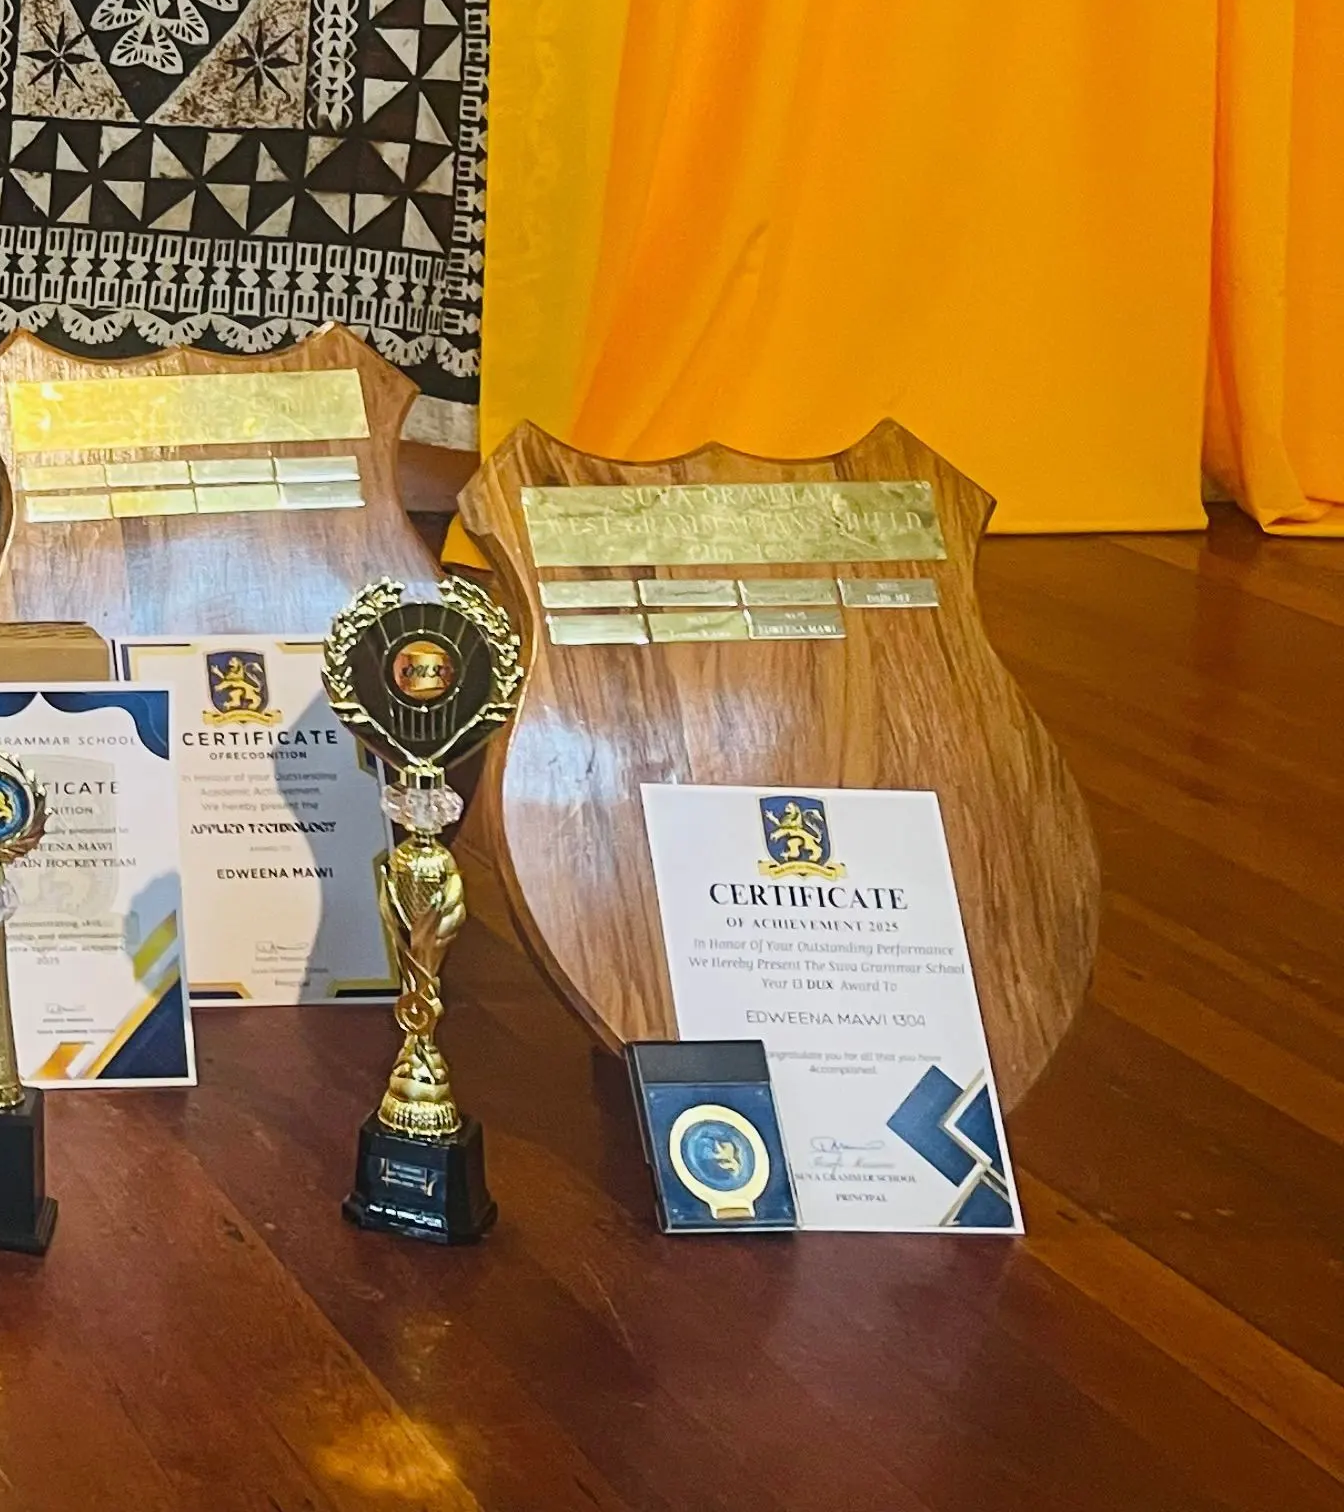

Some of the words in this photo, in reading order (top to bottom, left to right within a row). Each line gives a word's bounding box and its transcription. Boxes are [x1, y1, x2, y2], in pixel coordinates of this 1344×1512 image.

[78, 737, 137, 745] SCHOOL
[183, 730, 339, 746] CERTIFICATE
[46, 859, 99, 868] HOCKEY
[217, 868, 288, 879] EDWEENA
[293, 868, 333, 878] MAWI
[709, 883, 908, 910] CERTIFICATE
[726, 917, 744, 928] OF
[752, 918, 863, 932] ACHIEVEMENT
[766, 941, 793, 952] Your
[797, 941, 874, 956] Outstanding
[877, 943, 955, 957] Performance
[758, 959, 800, 972] Present
[804, 960, 826, 972] The
[807, 979, 833, 990] DUX
[746, 1010, 833, 1025] EDWEENA
[837, 1014, 887, 1026] MAWI
